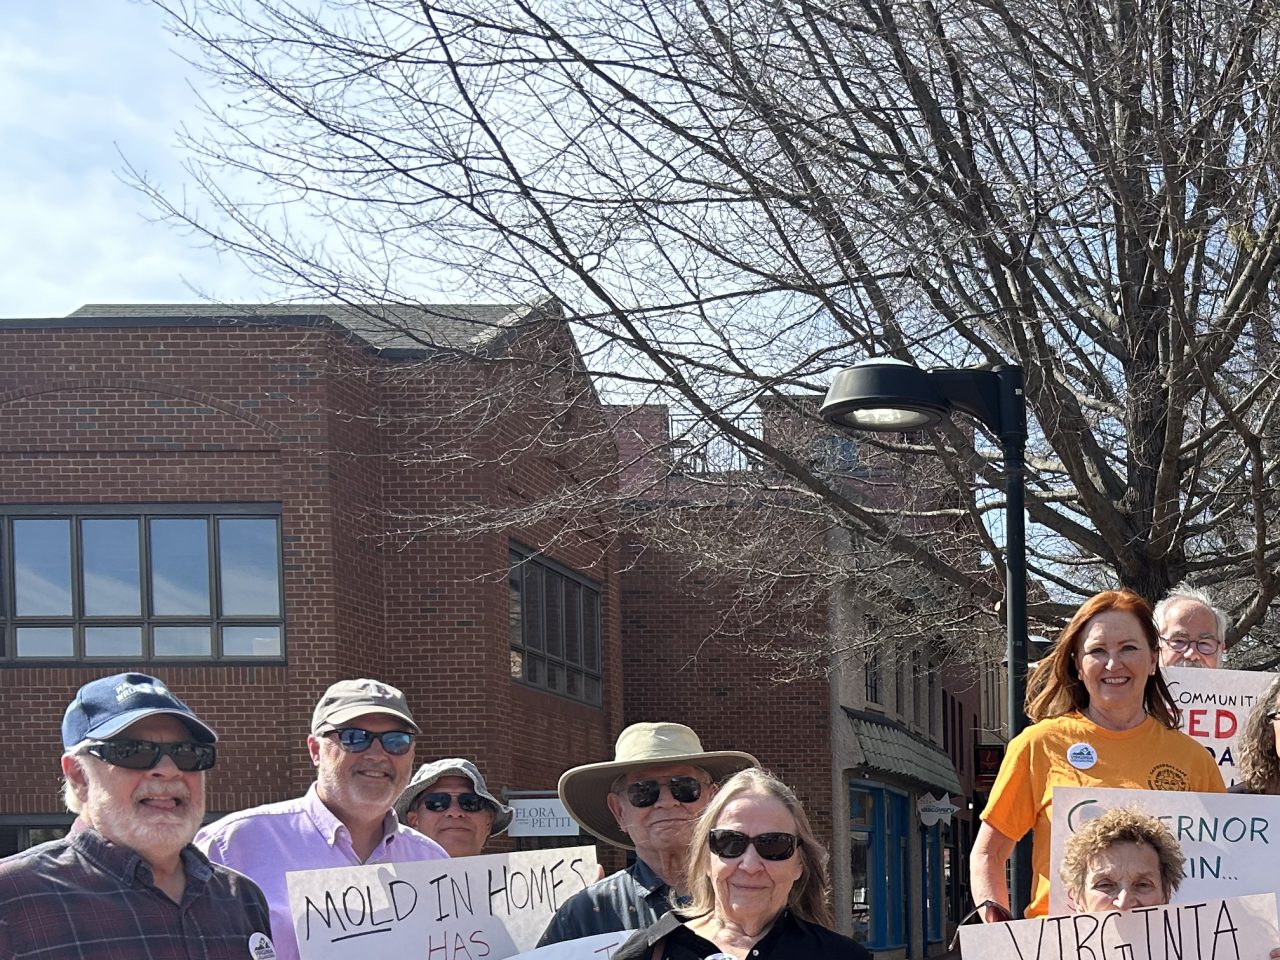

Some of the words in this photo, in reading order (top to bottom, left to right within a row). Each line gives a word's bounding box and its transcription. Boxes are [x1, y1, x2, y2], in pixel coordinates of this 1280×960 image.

[1168, 709, 1238, 739] ED
[515, 808, 556, 818] FLORA
[305, 880, 418, 941] MOLD
[429, 872, 474, 922] IN
[488, 858, 587, 917] HOMES
